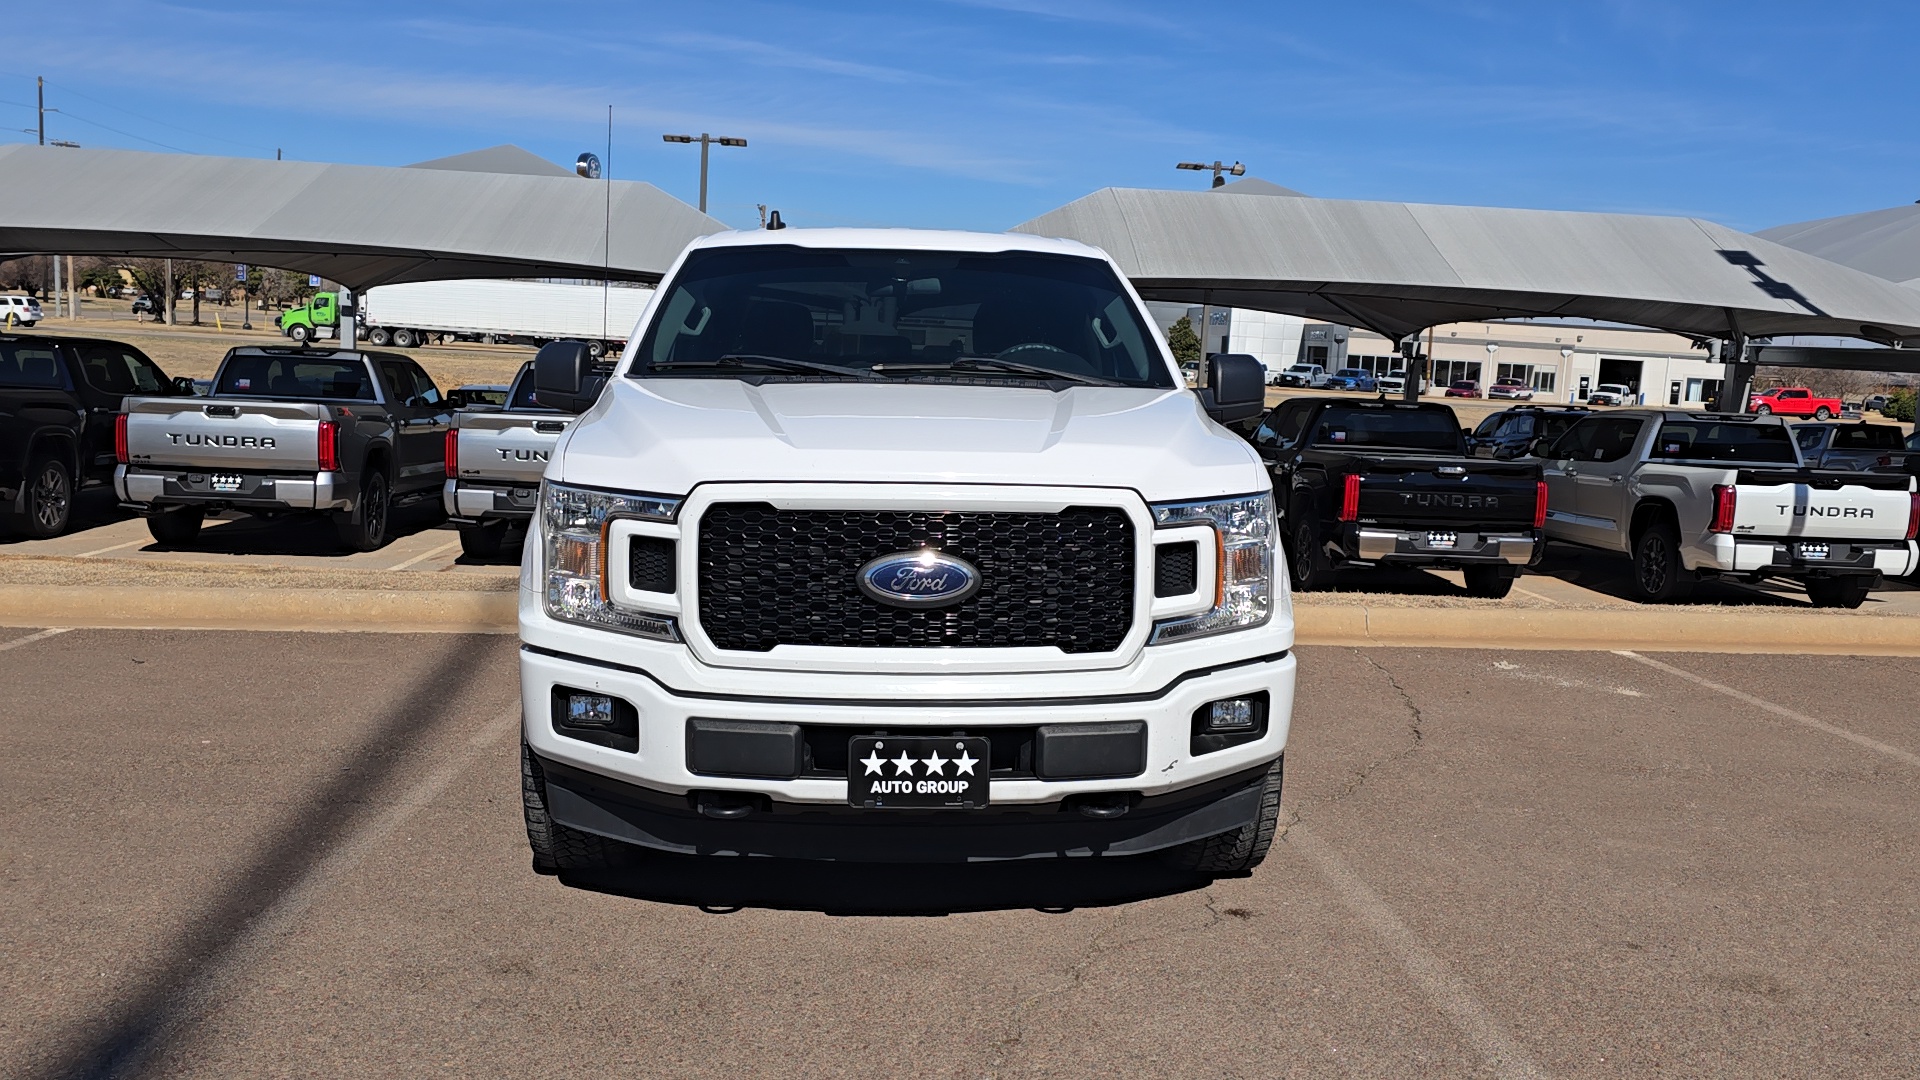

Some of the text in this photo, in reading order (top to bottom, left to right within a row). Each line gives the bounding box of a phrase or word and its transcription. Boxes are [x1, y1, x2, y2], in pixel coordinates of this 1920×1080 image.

[166, 433, 276, 450] TUNDRA
[1400, 493, 1499, 508] TUNDRA
[1776, 505, 1874, 518] TUNDRA
[891, 567, 948, 591] Ford
[870, 781, 969, 794] AUTO GROUP
